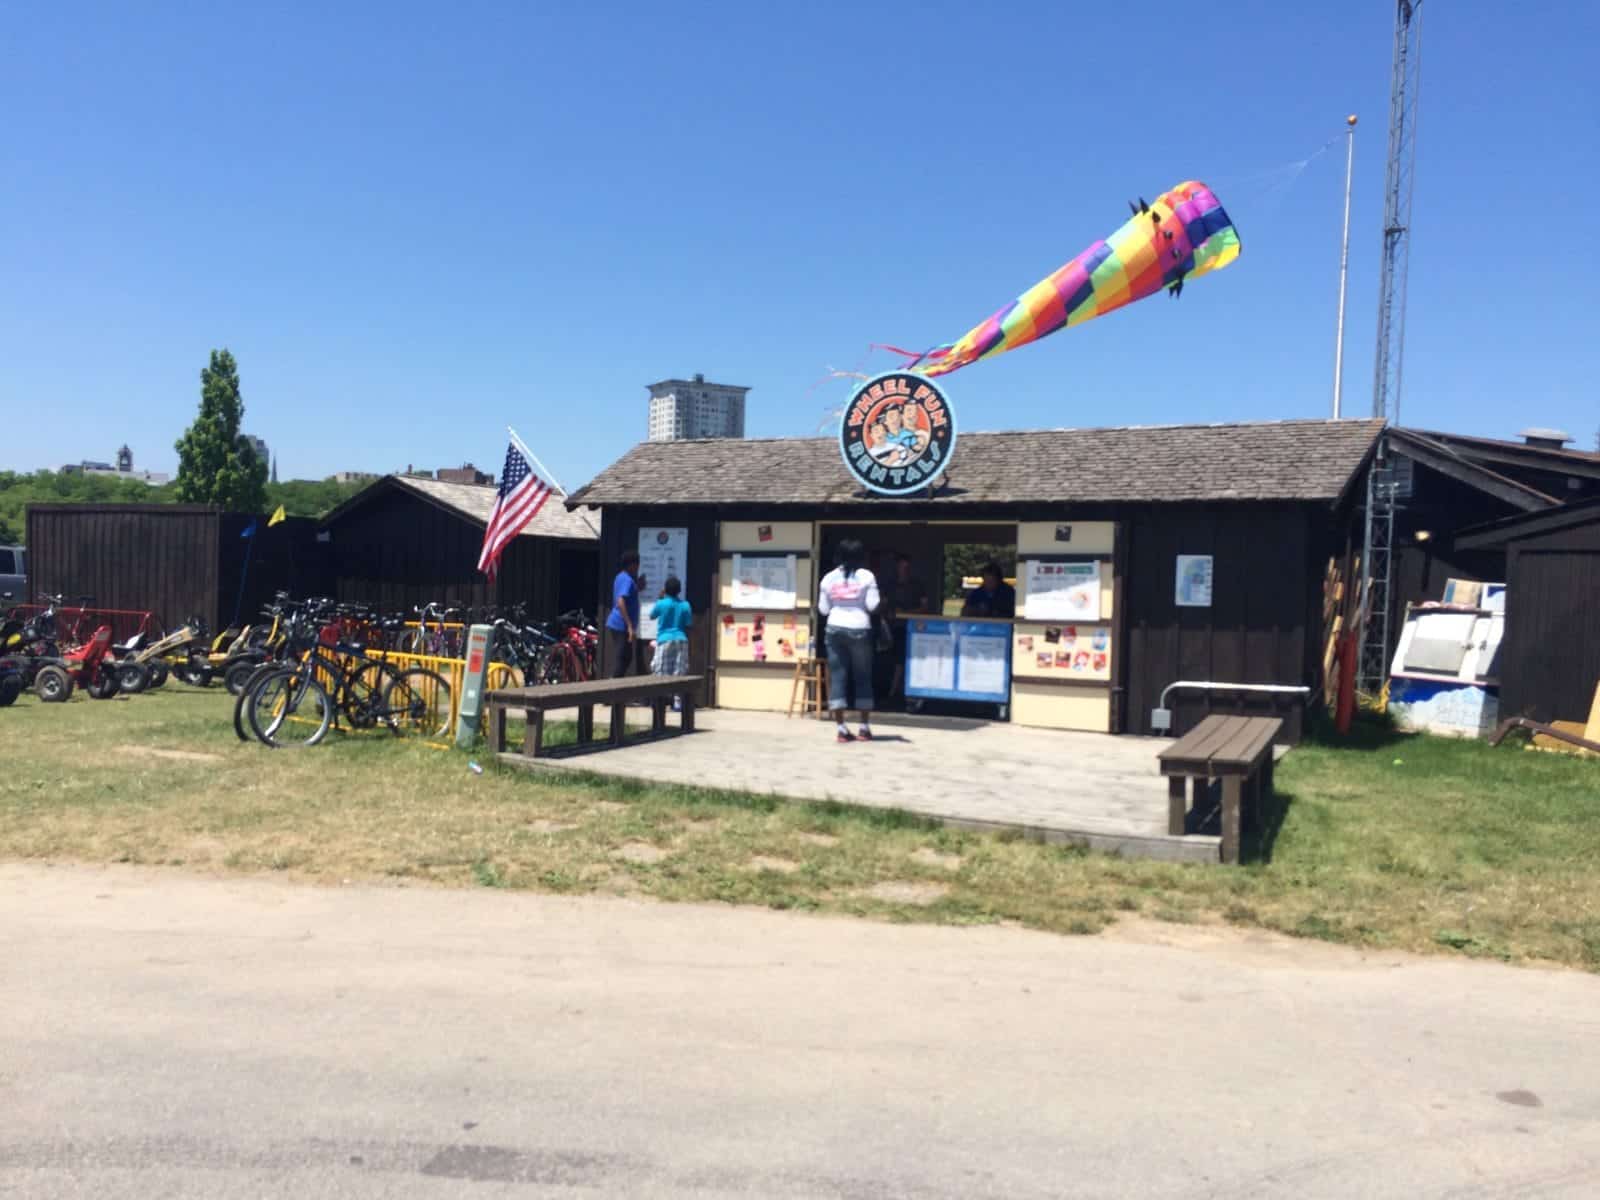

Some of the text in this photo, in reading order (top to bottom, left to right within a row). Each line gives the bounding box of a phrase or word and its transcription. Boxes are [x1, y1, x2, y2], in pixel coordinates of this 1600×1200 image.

[848, 379, 947, 427] WHEEL FUN
[848, 441, 941, 485] RENTALS
